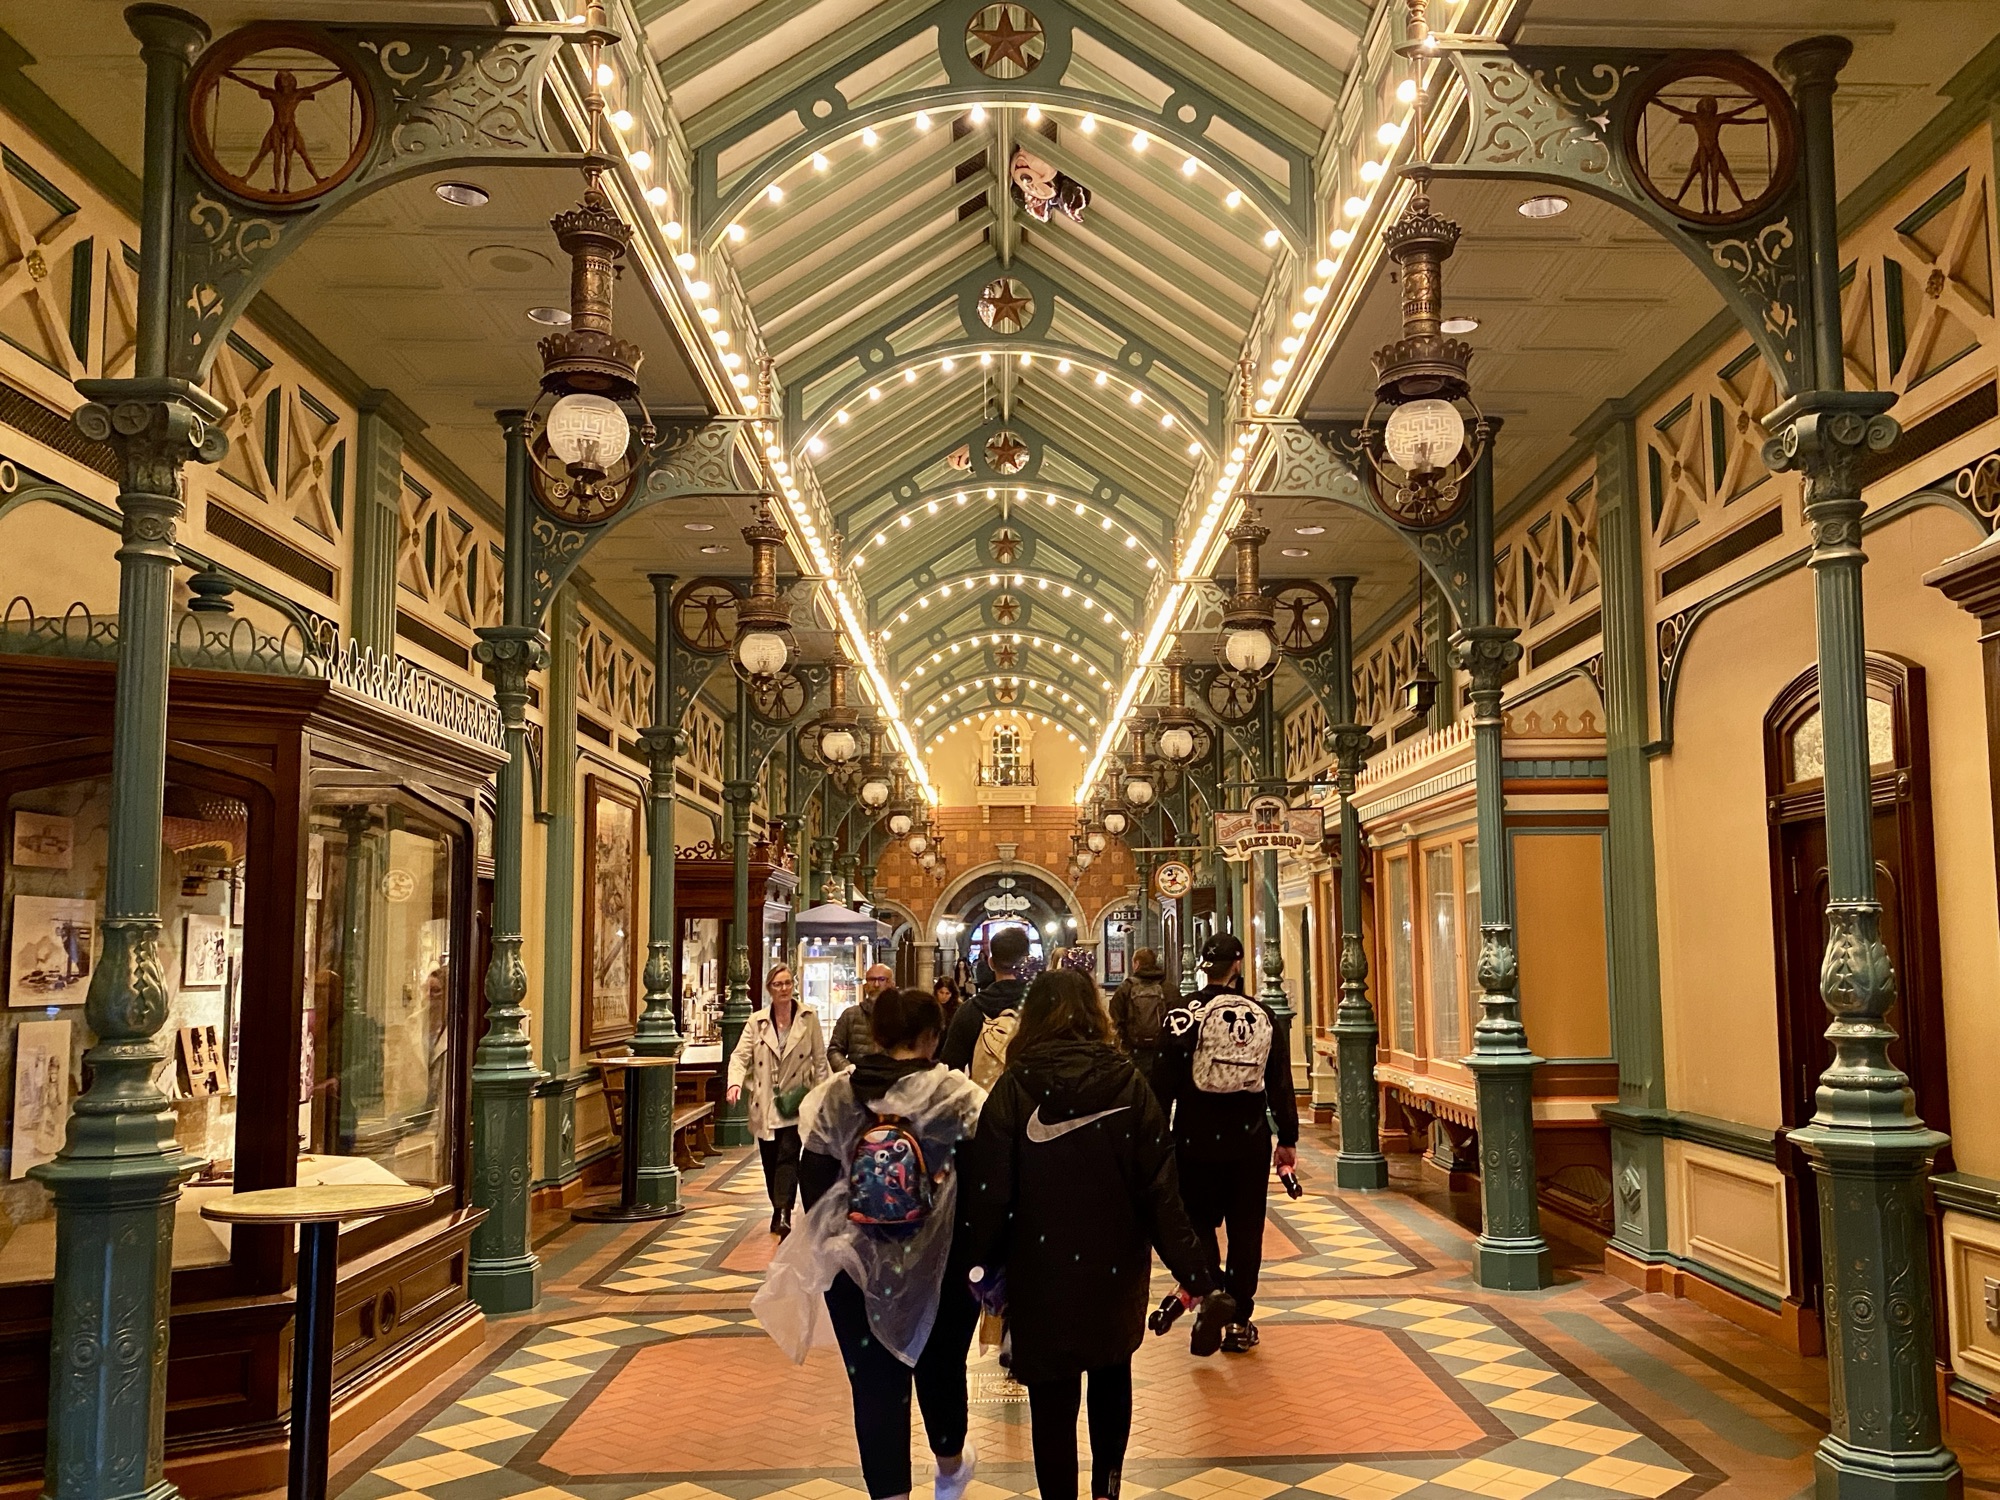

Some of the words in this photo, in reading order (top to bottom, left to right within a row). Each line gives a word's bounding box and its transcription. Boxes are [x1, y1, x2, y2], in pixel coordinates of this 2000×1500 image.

[1239, 836, 1268, 851] BAKE
[1271, 836, 1302, 849] SHOP
[1113, 912, 1138, 920] DELI
